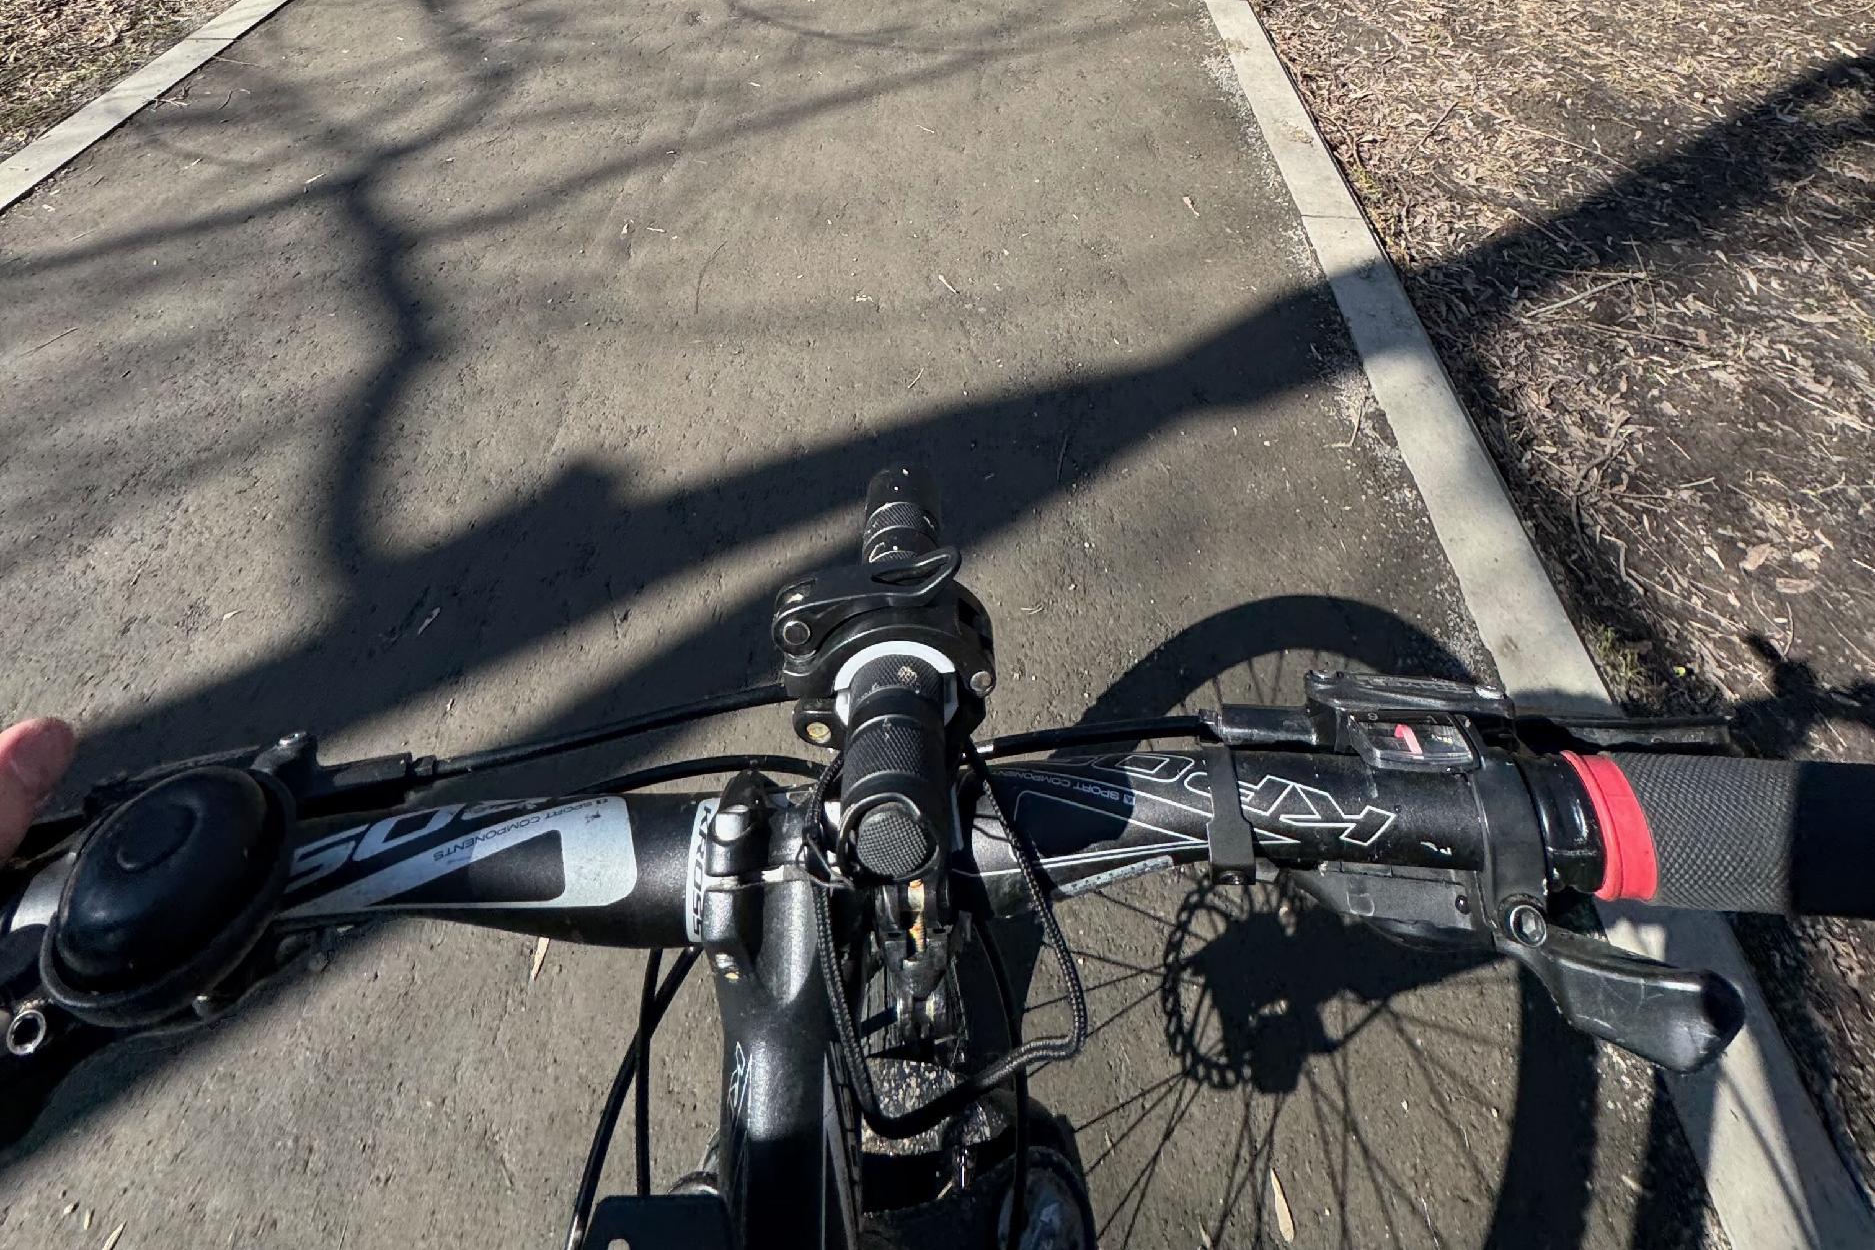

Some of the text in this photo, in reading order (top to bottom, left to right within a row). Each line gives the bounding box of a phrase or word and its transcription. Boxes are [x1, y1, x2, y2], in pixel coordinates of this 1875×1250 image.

[990, 770, 1121, 801] SPORT COMPONENT
[433, 800, 594, 862] SPORT COMPONENTS
[693, 805, 711, 936] KROSS
